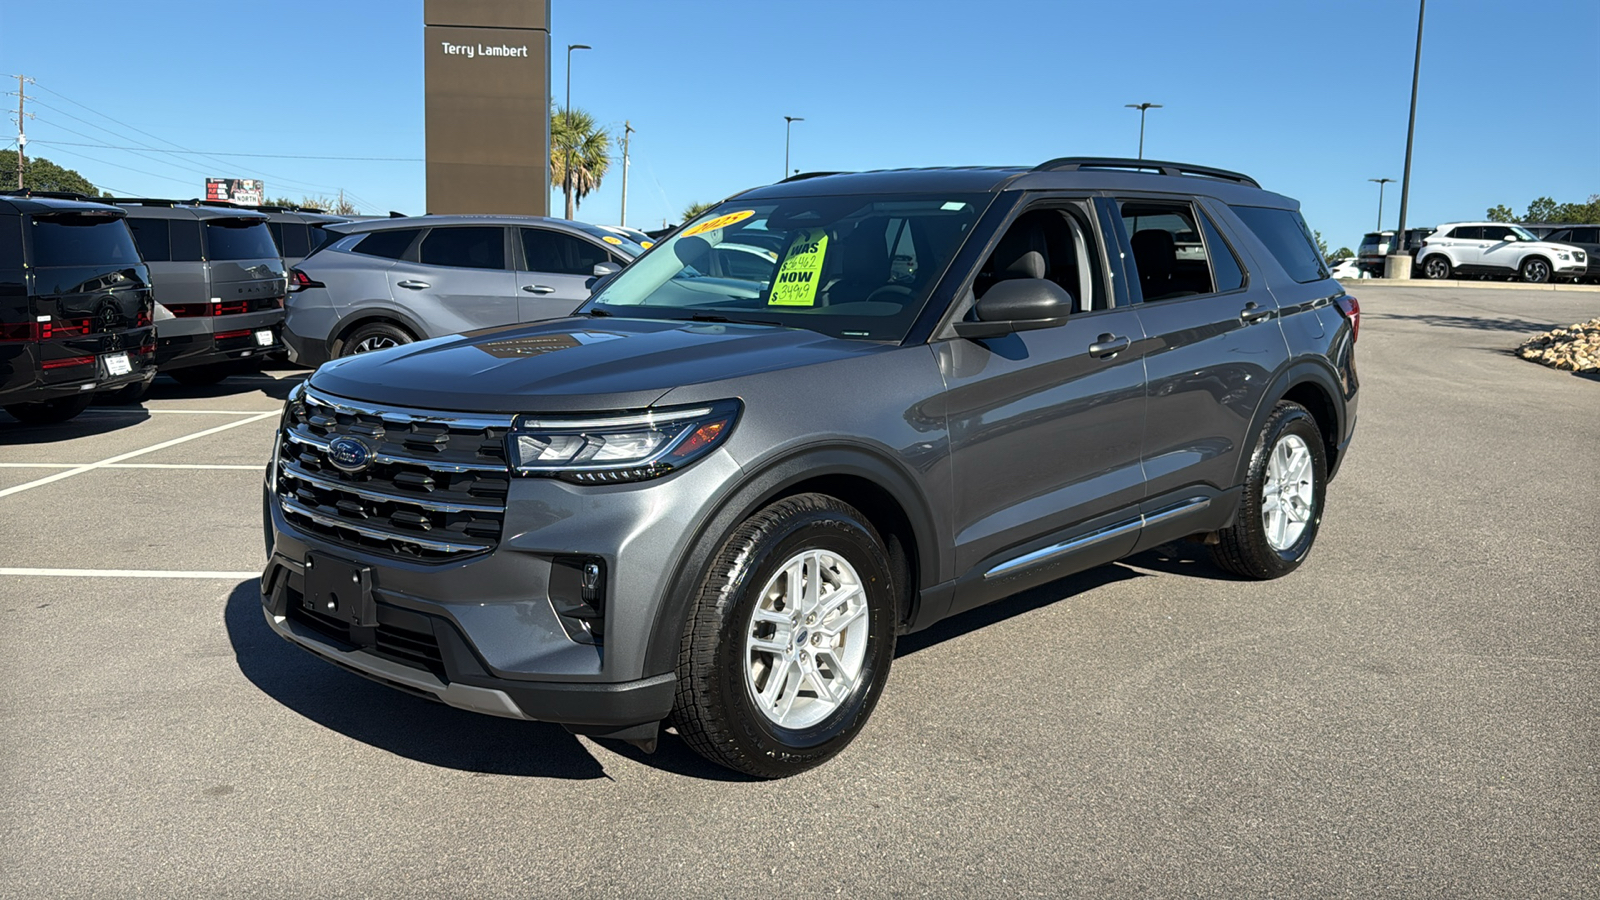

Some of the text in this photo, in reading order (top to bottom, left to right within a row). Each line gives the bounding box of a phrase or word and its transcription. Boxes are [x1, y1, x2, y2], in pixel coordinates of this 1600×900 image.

[441, 42, 528, 58] Terry Lambert
[236, 195, 257, 203] NORTH
[790, 242, 819, 256] WAS
[779, 271, 814, 284] NOW
